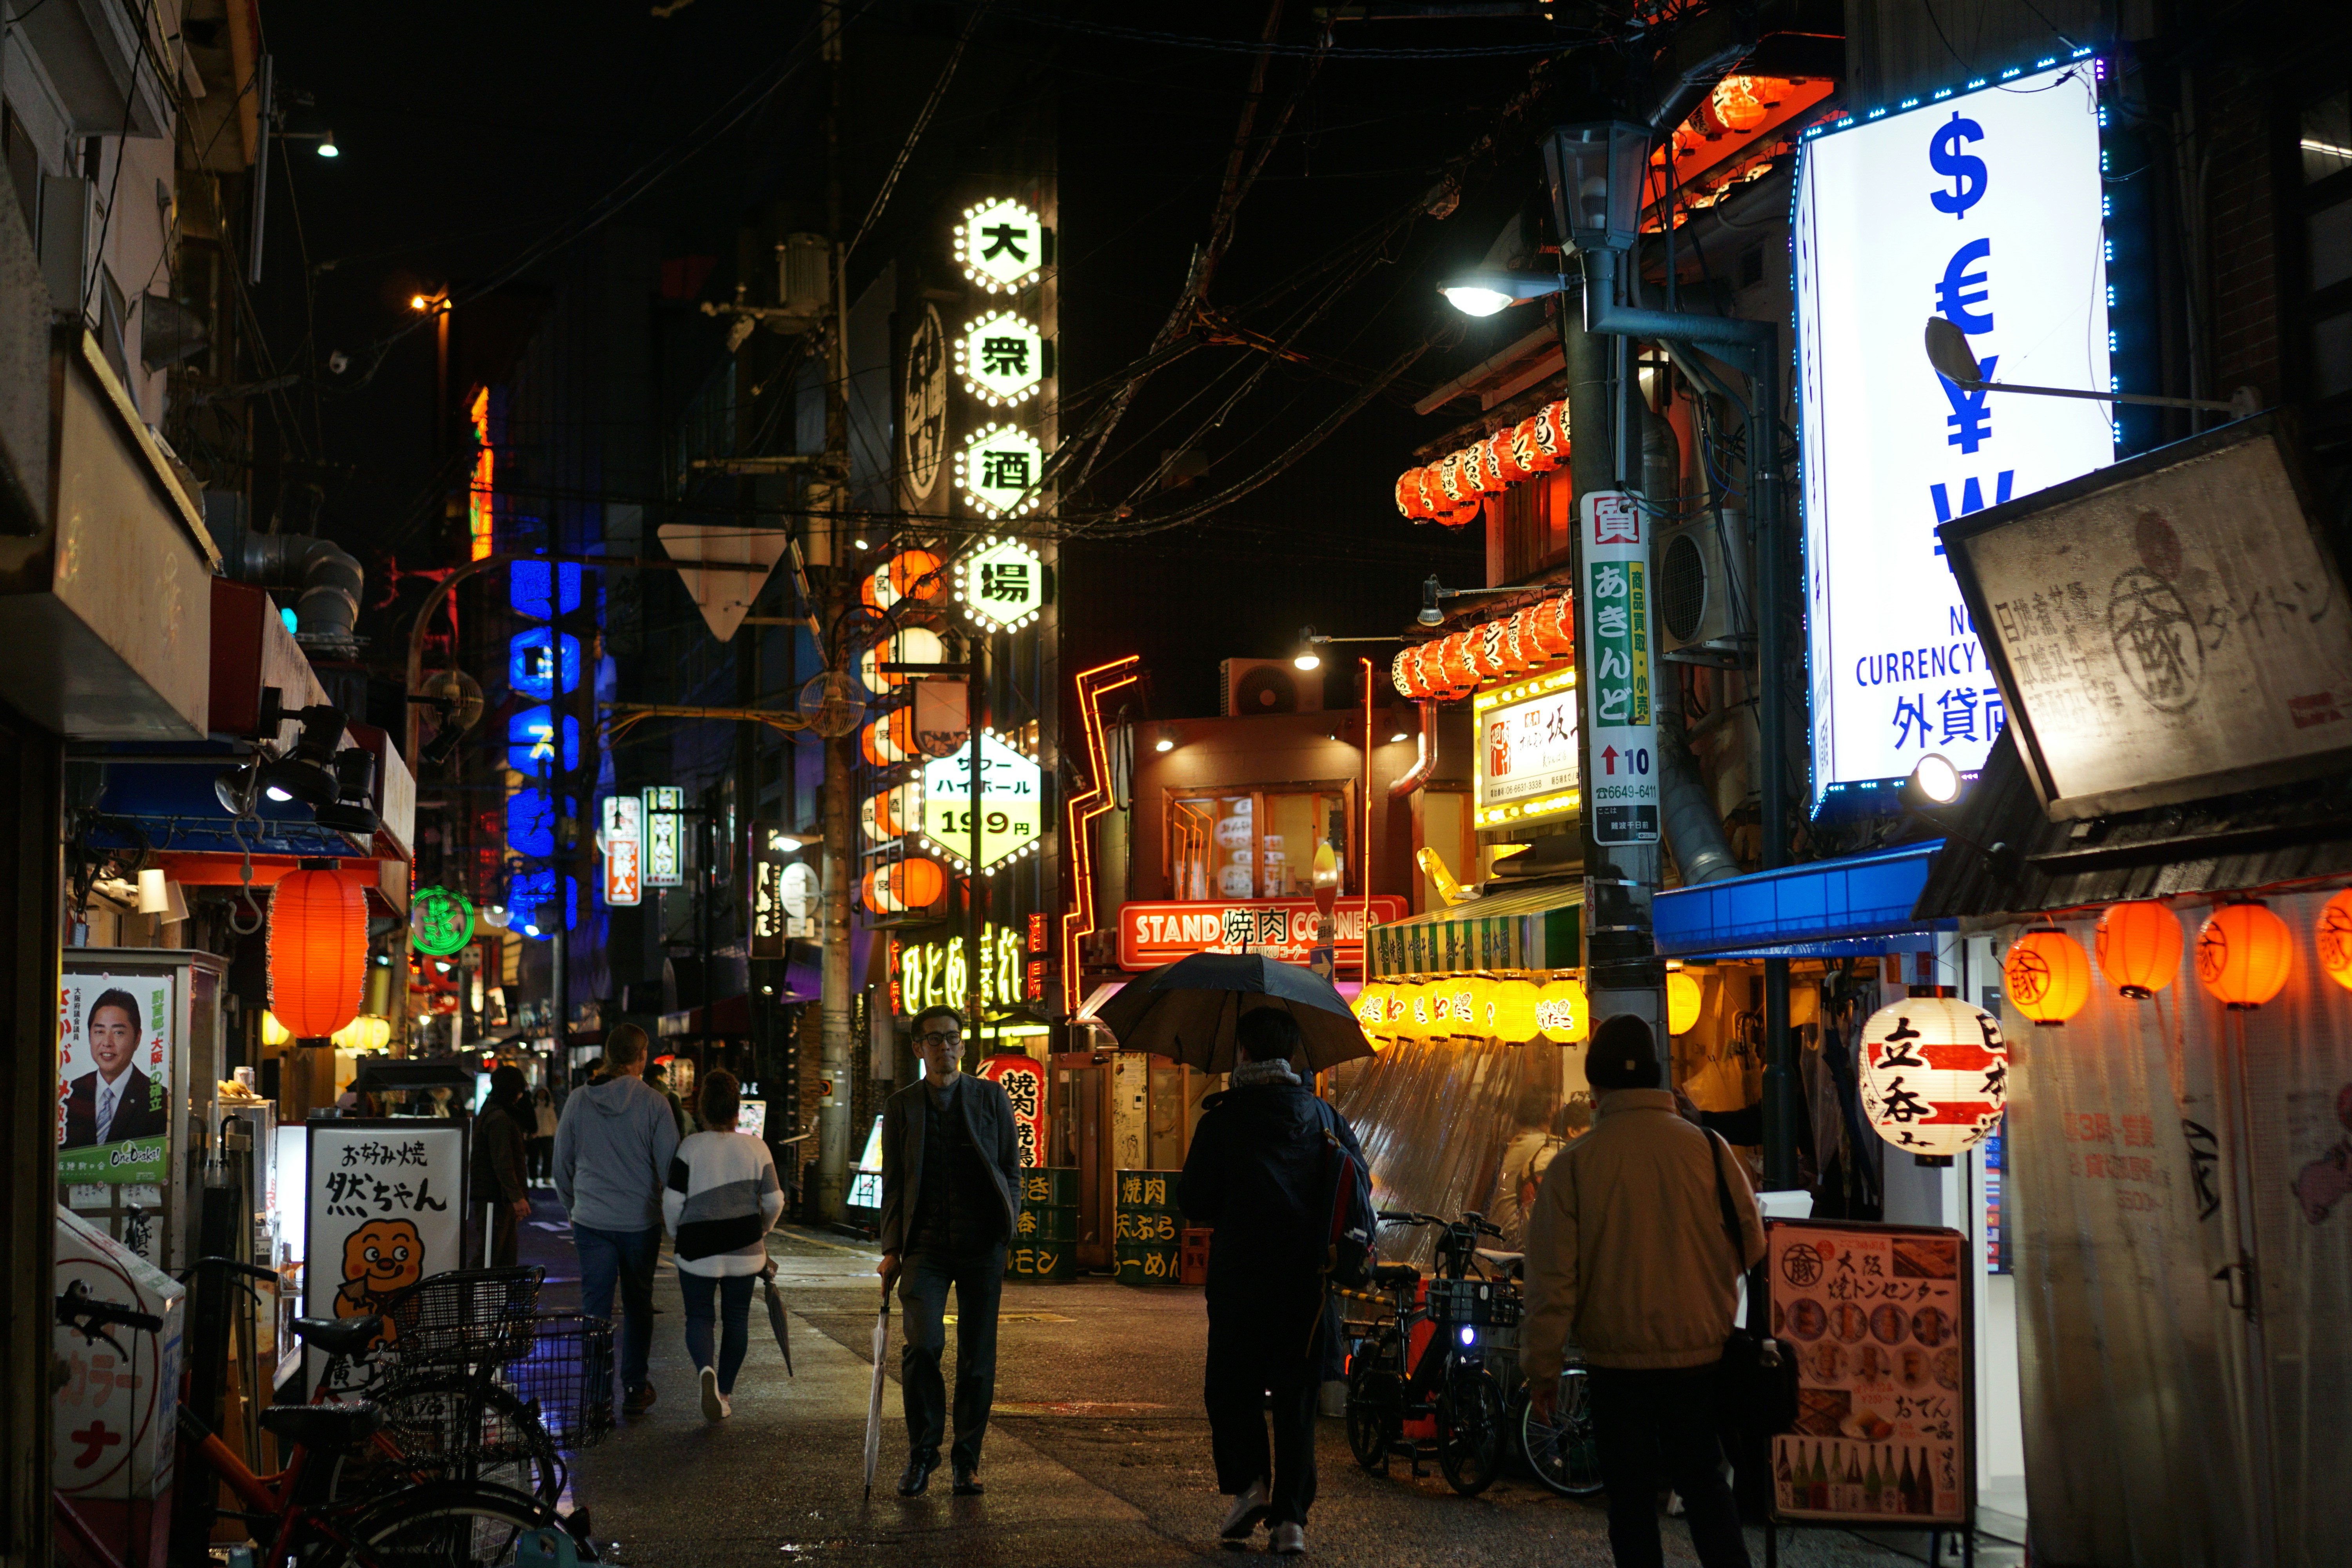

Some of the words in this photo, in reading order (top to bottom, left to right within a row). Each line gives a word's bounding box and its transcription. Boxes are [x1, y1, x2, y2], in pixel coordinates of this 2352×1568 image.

[1929, 111, 1989, 220] $
[1936, 237, 1994, 336] €
[982, 223, 1030, 603] 大衆酒場
[1936, 355, 1999, 455] ¥
[1595, 499, 1638, 542] 質
[1594, 566, 1632, 720] あきんど
[1857, 642, 1976, 686] CURRENCY
[1625, 748, 1649, 775] 10
[1608, 785, 1656, 799] 6649-6411
[1611, 821, 1649, 830] 難波千日前
[1136, 915, 1219, 943] STAND
[1224, 907, 1289, 945] 焼肉
[1377, 938, 1403, 964] たこ焼き
[1408, 936, 1435, 960] やきそば
[1446, 934, 1474, 960] 生ビール
[1484, 928, 1509, 959] 日本酒
[73, 986, 81, 1041] 大阪府議会議員
[1878, 1017, 1936, 1147] 立呑み
[342, 1141, 428, 1168] お好み焼
[326, 1172, 446, 1218] 然ちゃん
[1123, 1177, 1166, 1205] 焼肉
[1116, 1214, 1175, 1240] 天ぷら
[1837, 1250, 1884, 1278] 大阪
[1828, 1273, 1950, 1303] 焼トンセンター
[1895, 1396, 1951, 1418] おでん
